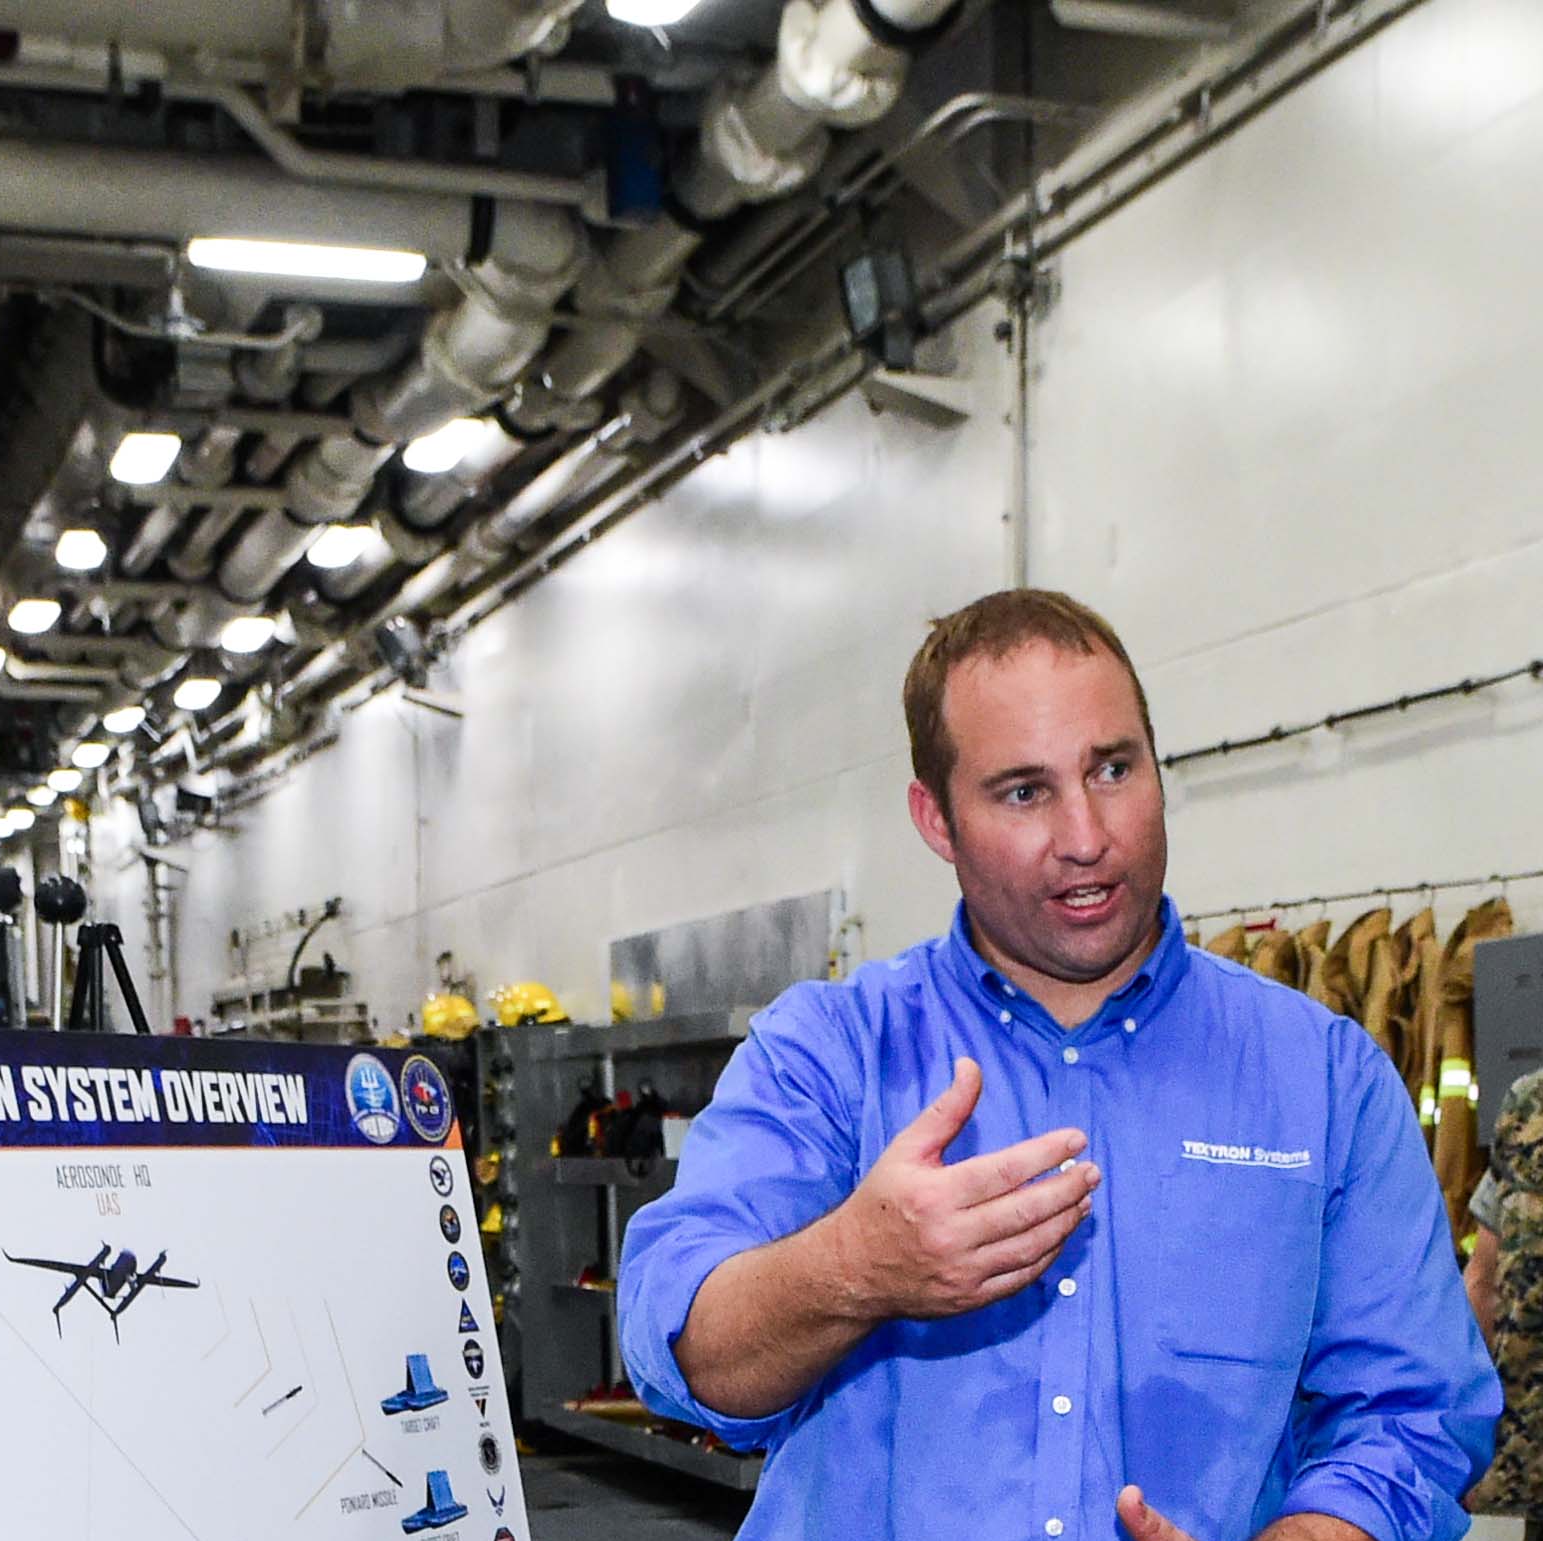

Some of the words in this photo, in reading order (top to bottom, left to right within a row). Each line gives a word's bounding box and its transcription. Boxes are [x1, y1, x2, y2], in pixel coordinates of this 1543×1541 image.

[21, 1066, 160, 1122] SYSTEM
[160, 1069, 307, 1124] OVERVIEW
[1182, 1140, 1250, 1159] TEXTRON
[56, 1164, 125, 1189] AEROSONDE
[133, 1163, 152, 1187] HQ
[96, 1191, 121, 1216] UAS
